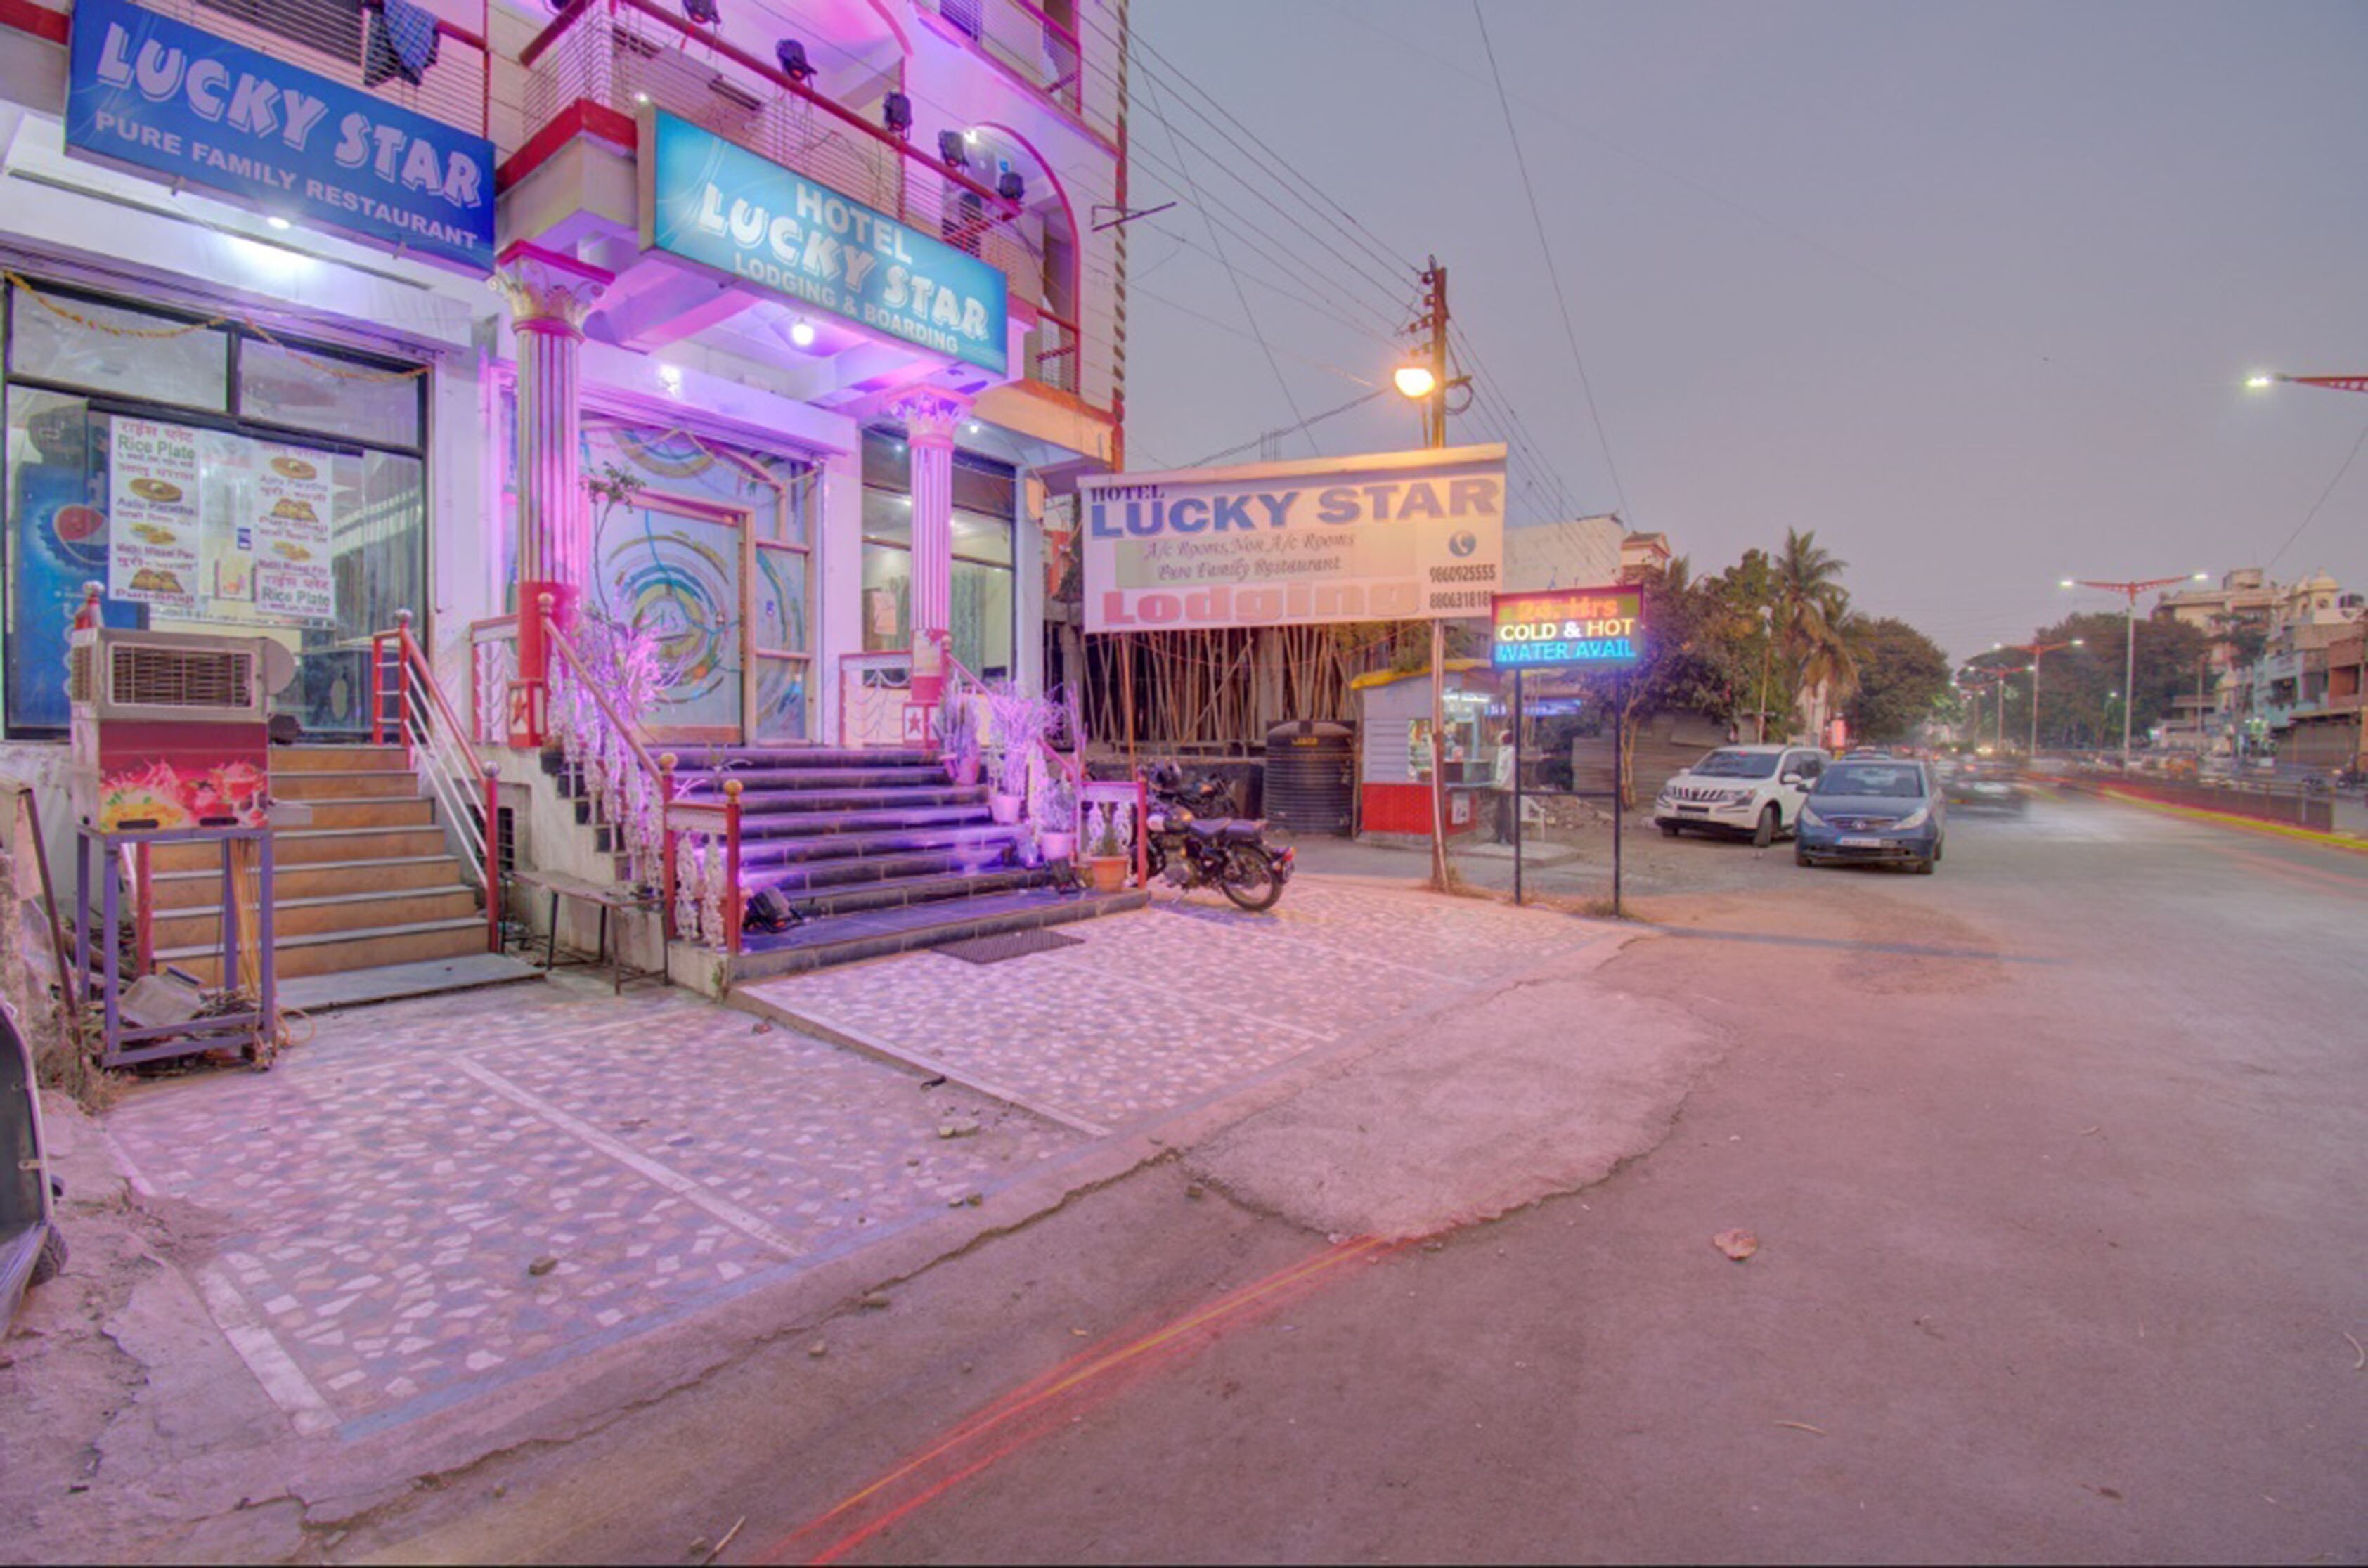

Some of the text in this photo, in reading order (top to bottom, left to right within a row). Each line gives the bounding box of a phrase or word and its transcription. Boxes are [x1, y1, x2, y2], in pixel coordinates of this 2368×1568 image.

[97, 22, 481, 208] LUCKY STAR
[96, 112, 477, 250] PURE FAMILY RESTAURANT
[796, 183, 912, 264] HOTEL
[698, 183, 989, 340] LUCKY STAR
[735, 252, 958, 352] LODGING & BOARDING
[118, 434, 195, 460] Rice Plate
[1091, 484, 1165, 502] HOTEL
[1092, 478, 1500, 539] LUCKY STAR
[1303, 532, 1355, 551] Rooms
[1158, 555, 1341, 581] Pure Family Restaurant
[262, 586, 330, 607] Rice Plate
[1103, 582, 1421, 625] Lodging
[1500, 618, 1635, 641] COLD & HOT
[1496, 638, 1637, 662] WATER AVAIL
